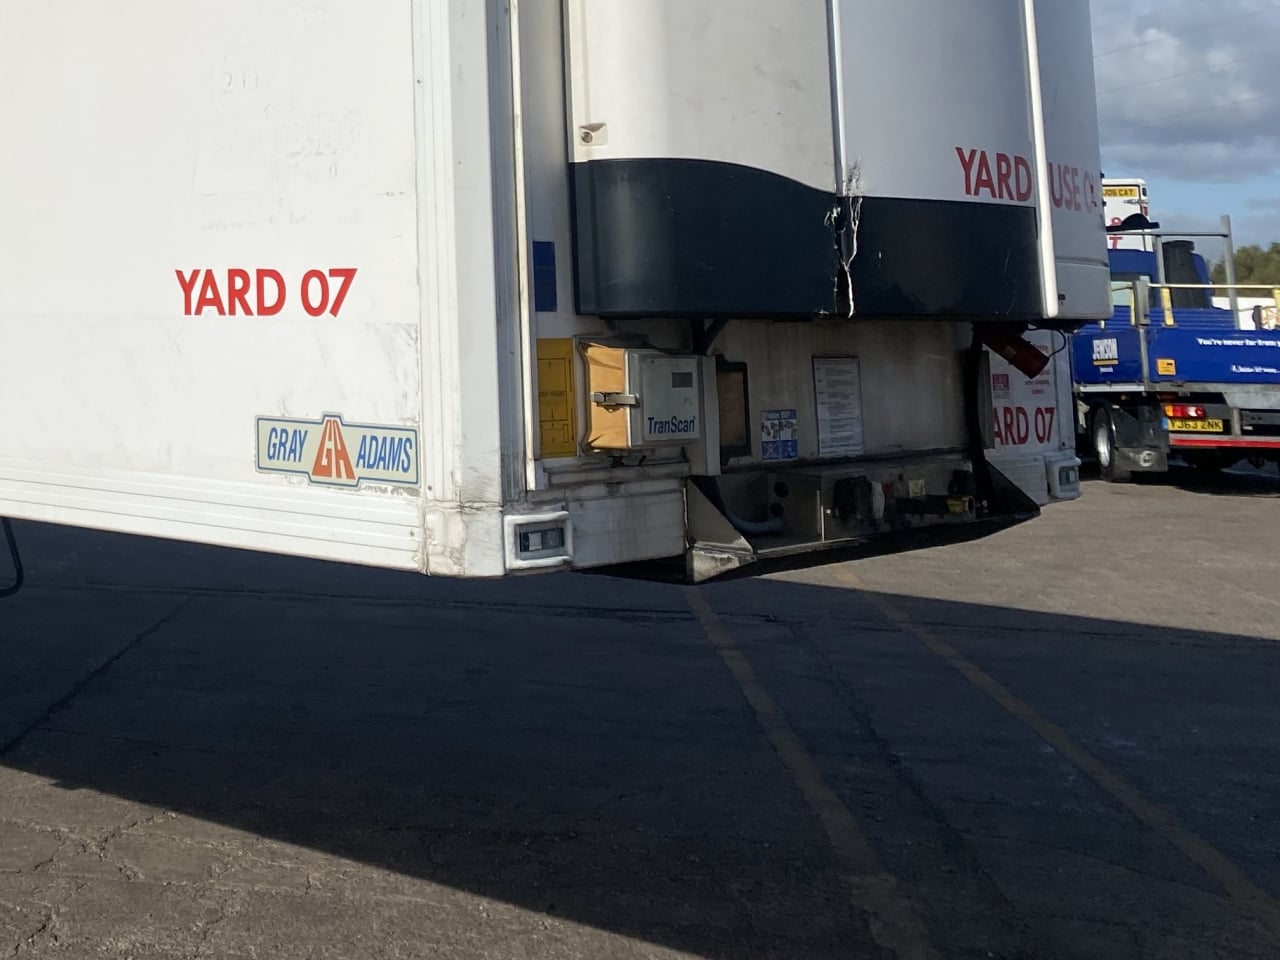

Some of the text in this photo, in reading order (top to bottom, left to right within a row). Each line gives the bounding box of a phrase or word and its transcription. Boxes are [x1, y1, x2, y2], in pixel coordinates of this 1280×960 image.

[955, 146, 1033, 203] YARD
[1048, 161, 1081, 211] USE
[175, 267, 359, 318] YARD 07
[647, 414, 696, 435] TranScan
[993, 406, 1056, 446] ARD 07
[267, 427, 308, 463] GRAY
[356, 434, 413, 473] ADAMS
